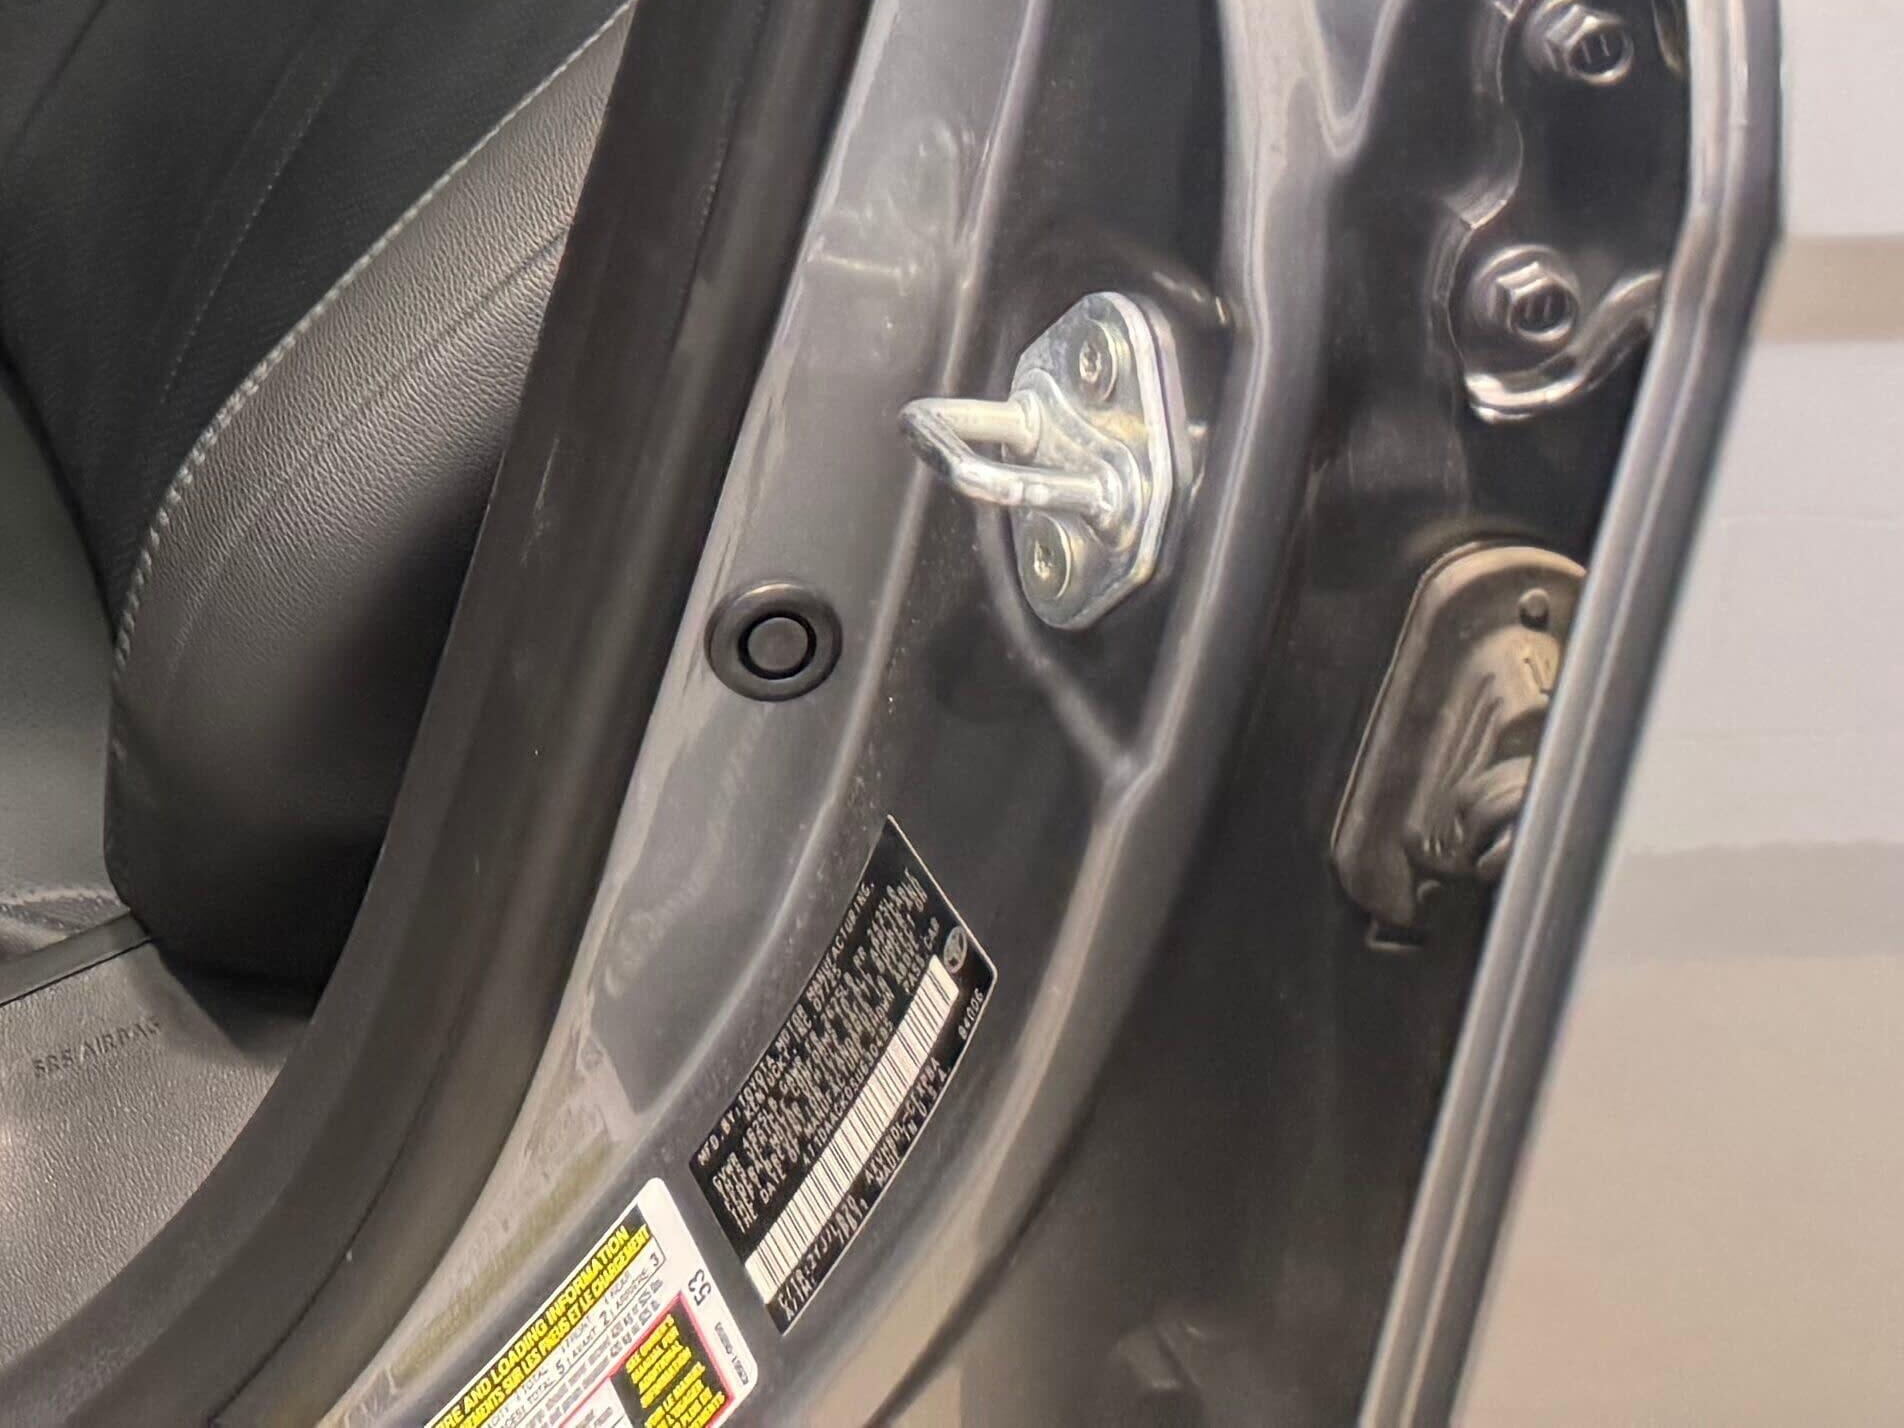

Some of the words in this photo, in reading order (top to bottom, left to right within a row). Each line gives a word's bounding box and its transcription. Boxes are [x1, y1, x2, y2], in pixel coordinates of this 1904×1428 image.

[32, 1047, 74, 1078] SRS
[461, 1375, 491, 1415] AND
[492, 1317, 545, 1384] LOADING
[549, 1227, 625, 1322] INFORMATION
[554, 1358, 565, 1375] 5
[599, 1309, 610, 1326] 2
[649, 1252, 659, 1267] 3
[687, 1267, 711, 1305] 53
